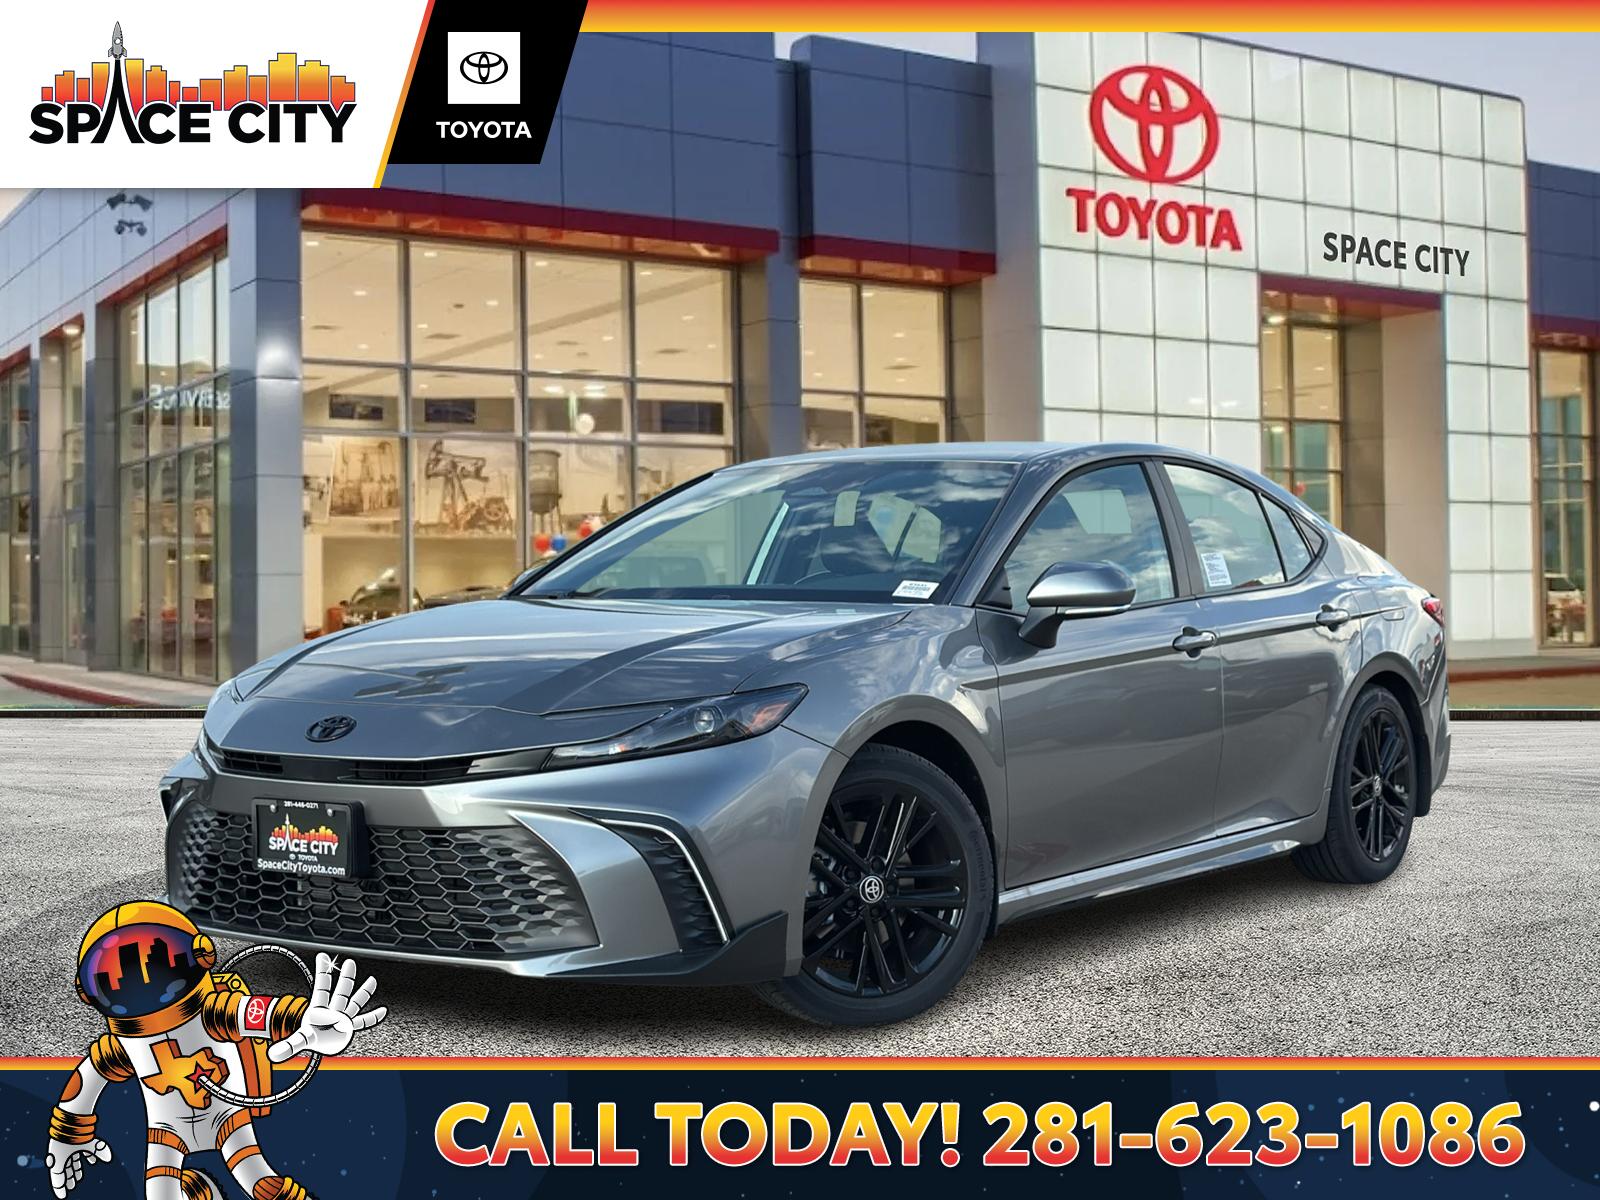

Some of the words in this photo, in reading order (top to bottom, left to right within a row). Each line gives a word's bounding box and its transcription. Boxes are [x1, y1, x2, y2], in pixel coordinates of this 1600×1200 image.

[1066, 187, 1243, 251] TOYOTA
[1323, 231, 1407, 270] SPACE
[1415, 243, 1471, 277] CITY
[269, 837, 307, 853] SPACE
[310, 841, 338, 855] CITY
[257, 858, 345, 875] SpaceCityToyota.com
[298, 854, 318, 862] TOYOTA
